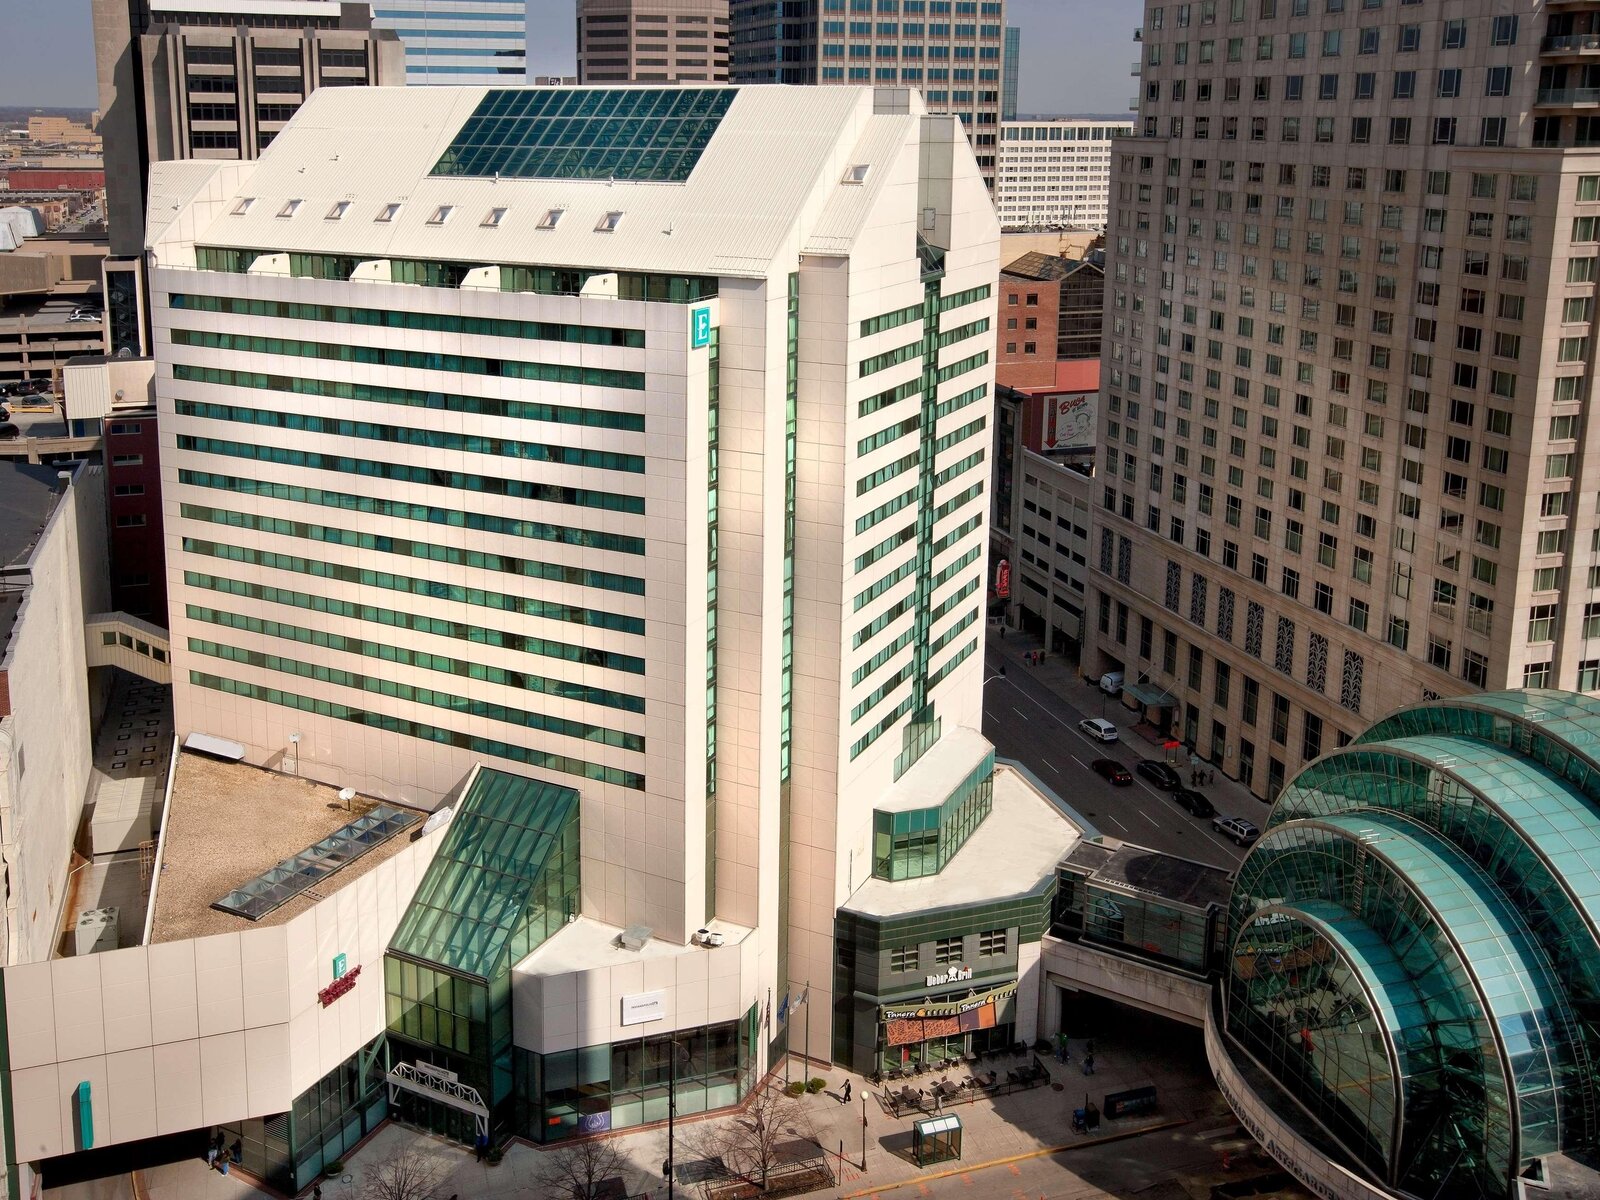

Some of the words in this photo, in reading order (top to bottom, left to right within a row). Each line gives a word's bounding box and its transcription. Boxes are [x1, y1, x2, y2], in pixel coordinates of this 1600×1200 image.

[698, 314, 708, 340] E
[926, 974, 949, 987] Weber
[957, 967, 973, 981] Grill
